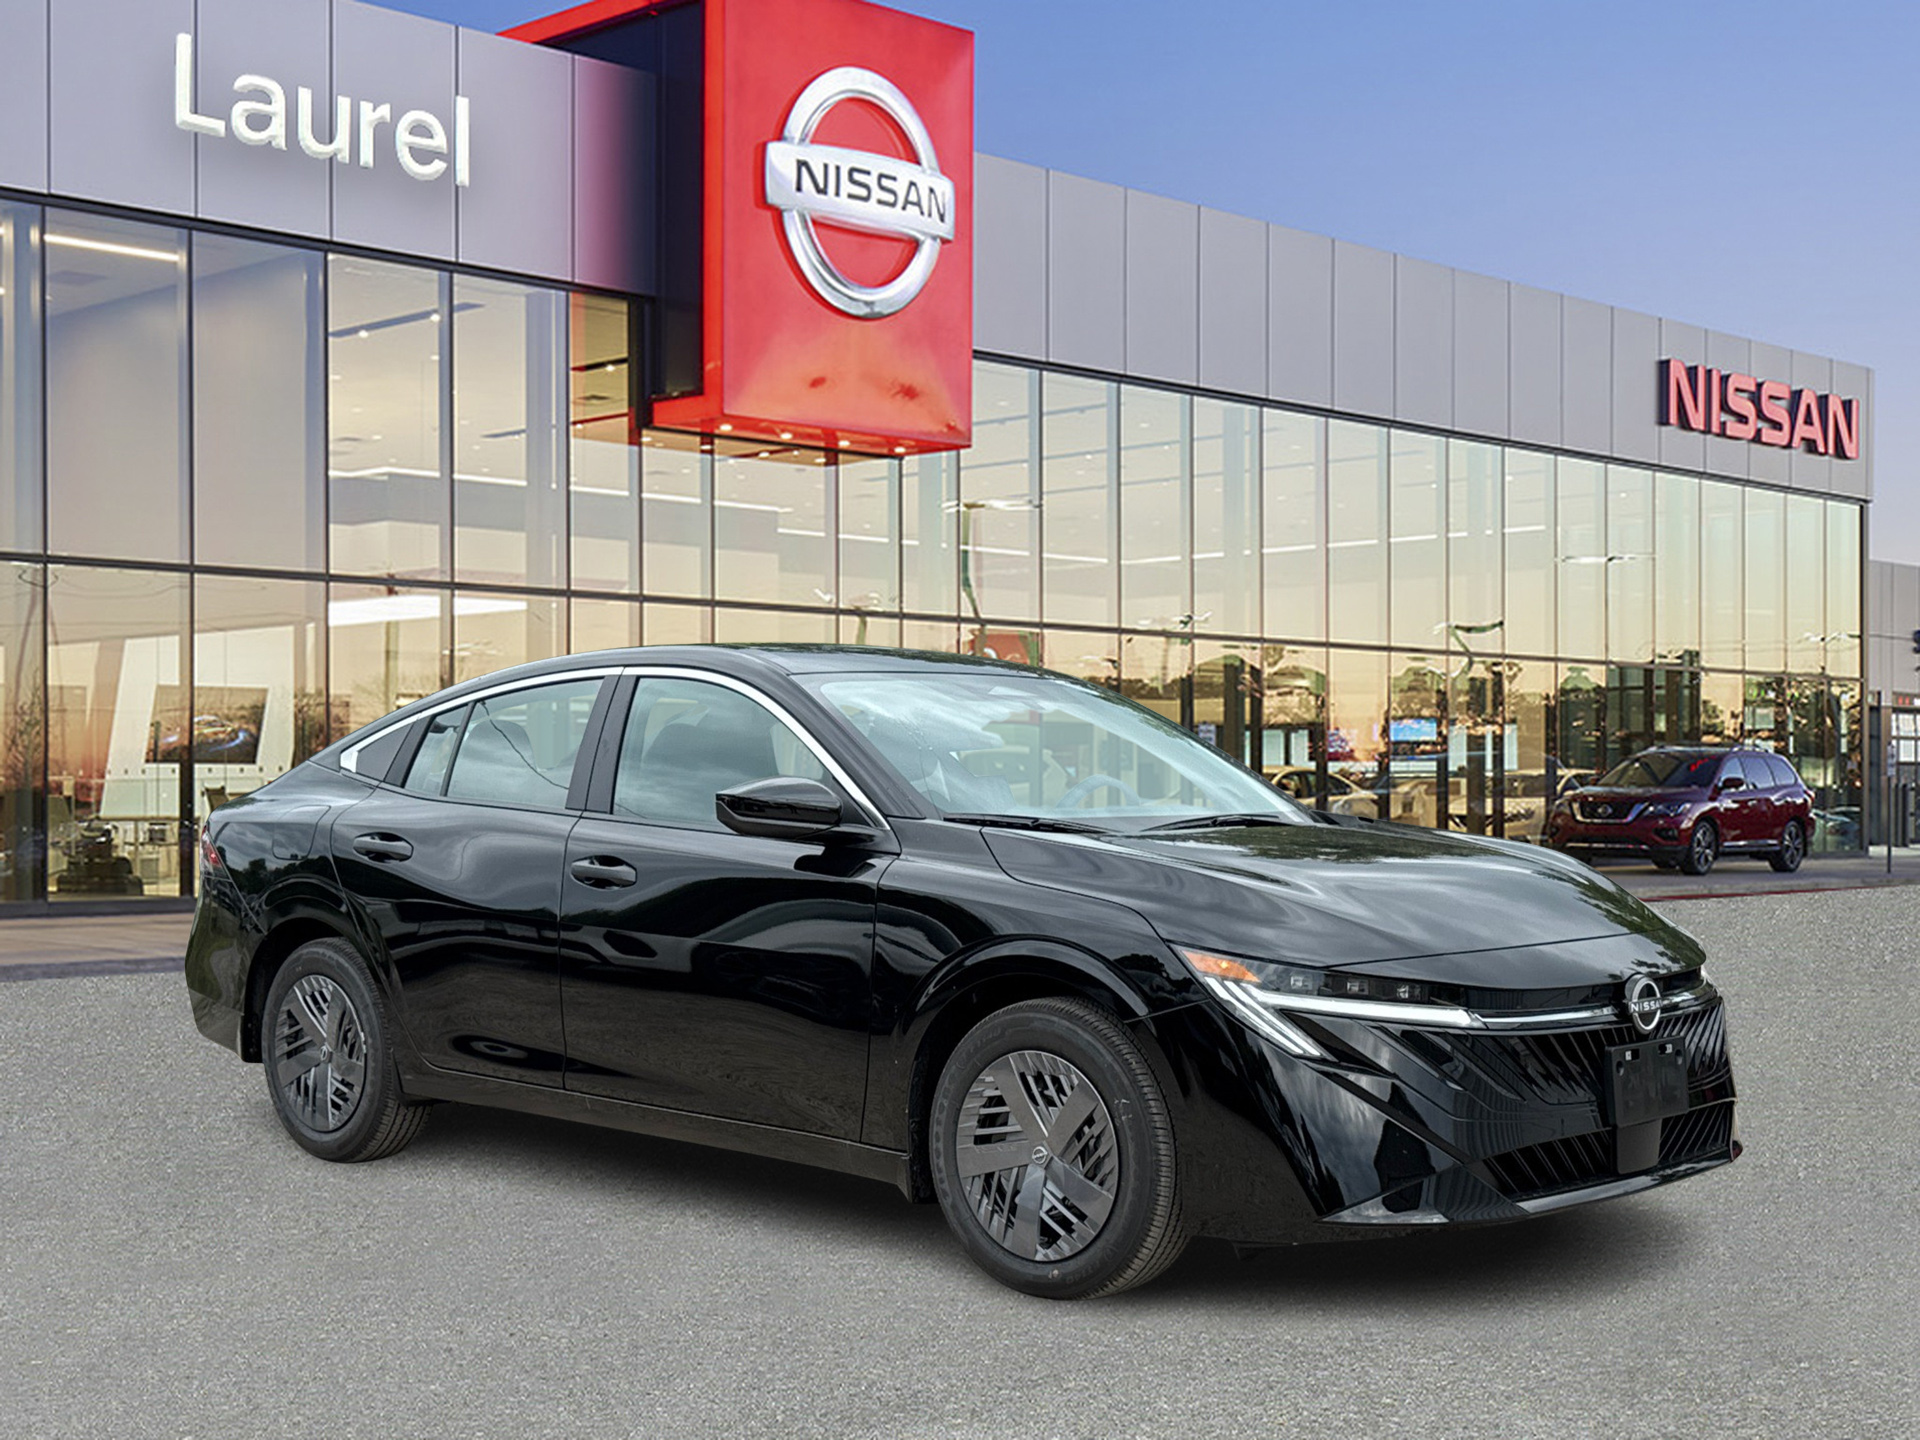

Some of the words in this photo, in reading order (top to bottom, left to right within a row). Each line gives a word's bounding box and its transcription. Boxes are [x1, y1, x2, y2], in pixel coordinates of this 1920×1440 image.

[175, 32, 469, 188] Laurel
[795, 158, 946, 224] NISSAN
[1658, 358, 1859, 459] NISSAN
